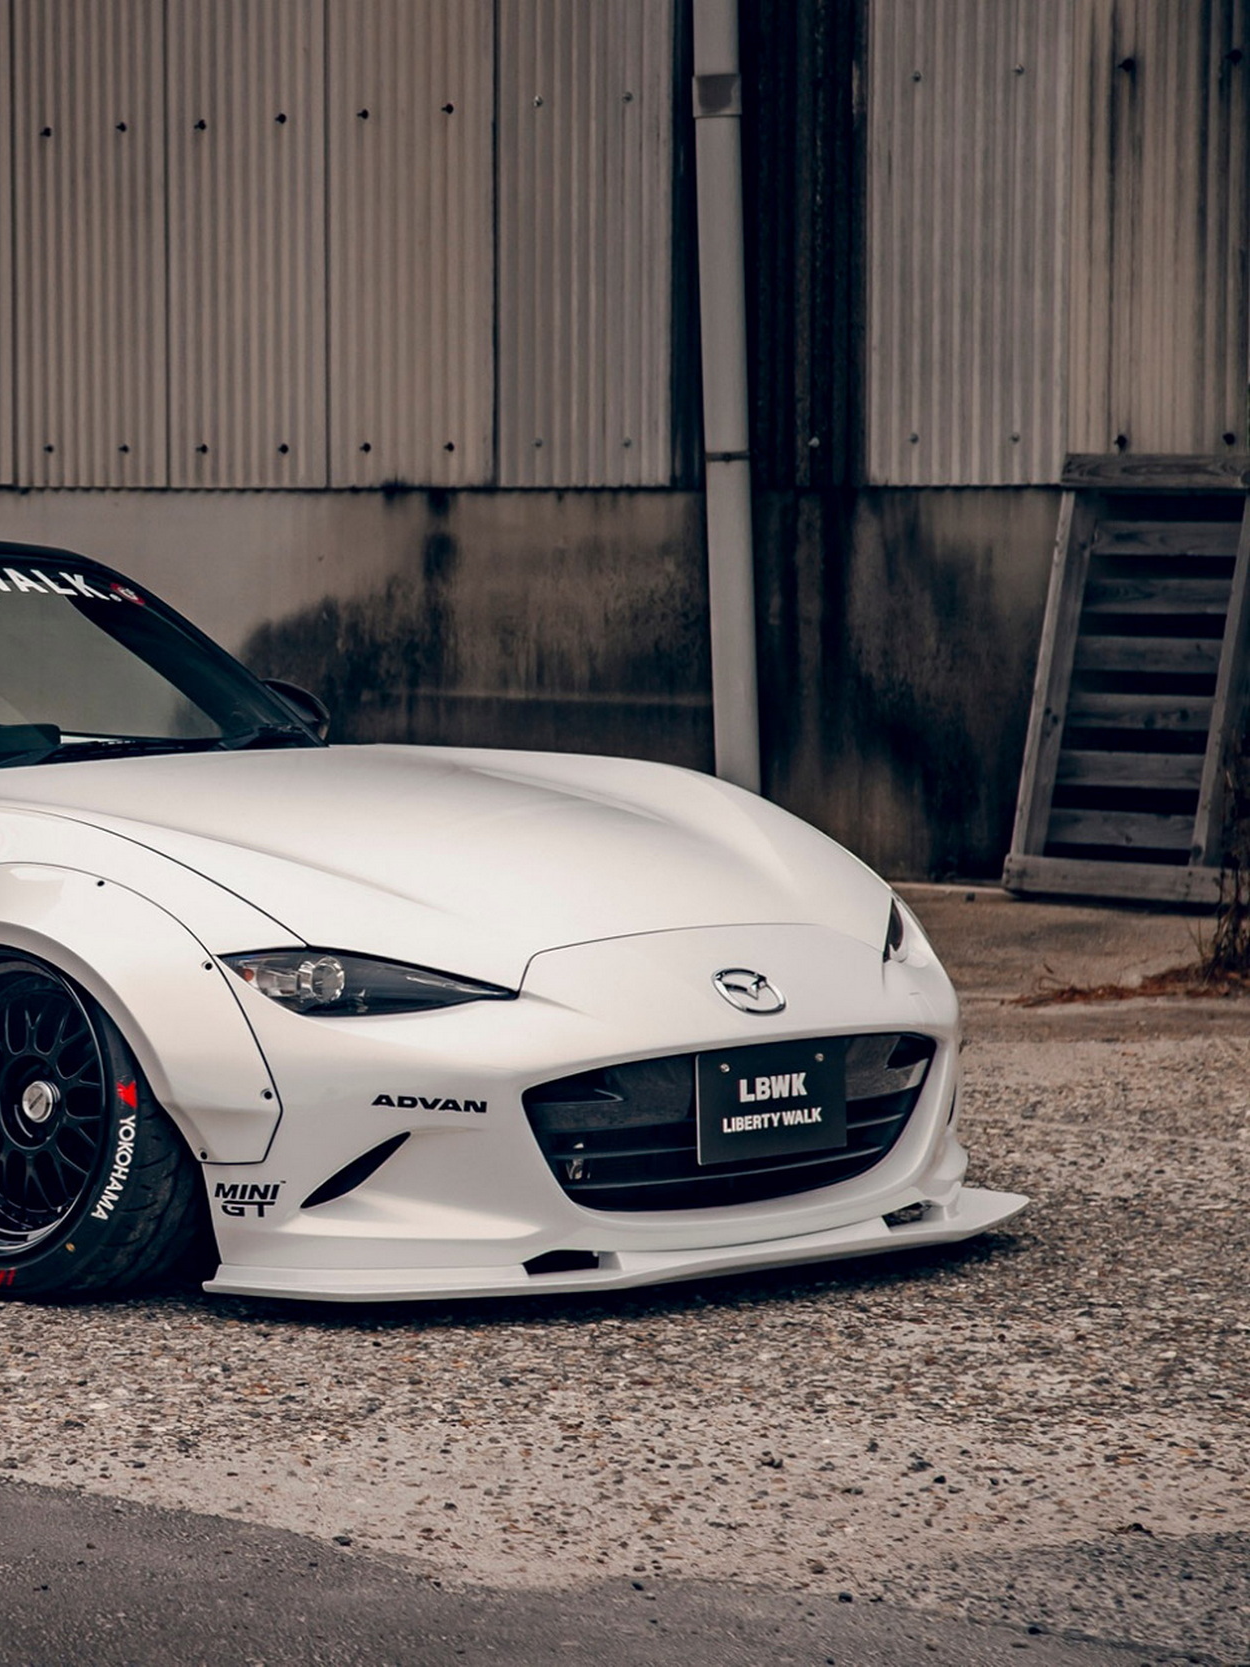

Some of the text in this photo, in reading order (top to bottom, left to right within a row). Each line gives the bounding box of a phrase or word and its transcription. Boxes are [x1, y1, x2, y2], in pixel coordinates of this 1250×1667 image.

[739, 1072, 808, 1103] LBWK
[372, 1094, 488, 1113] ADVAN
[722, 1106, 822, 1134] LIBERTY WALK
[91, 1114, 136, 1220] YOKOHAMA
[214, 1183, 280, 1200] MINI
[221, 1200, 276, 1217] GT
